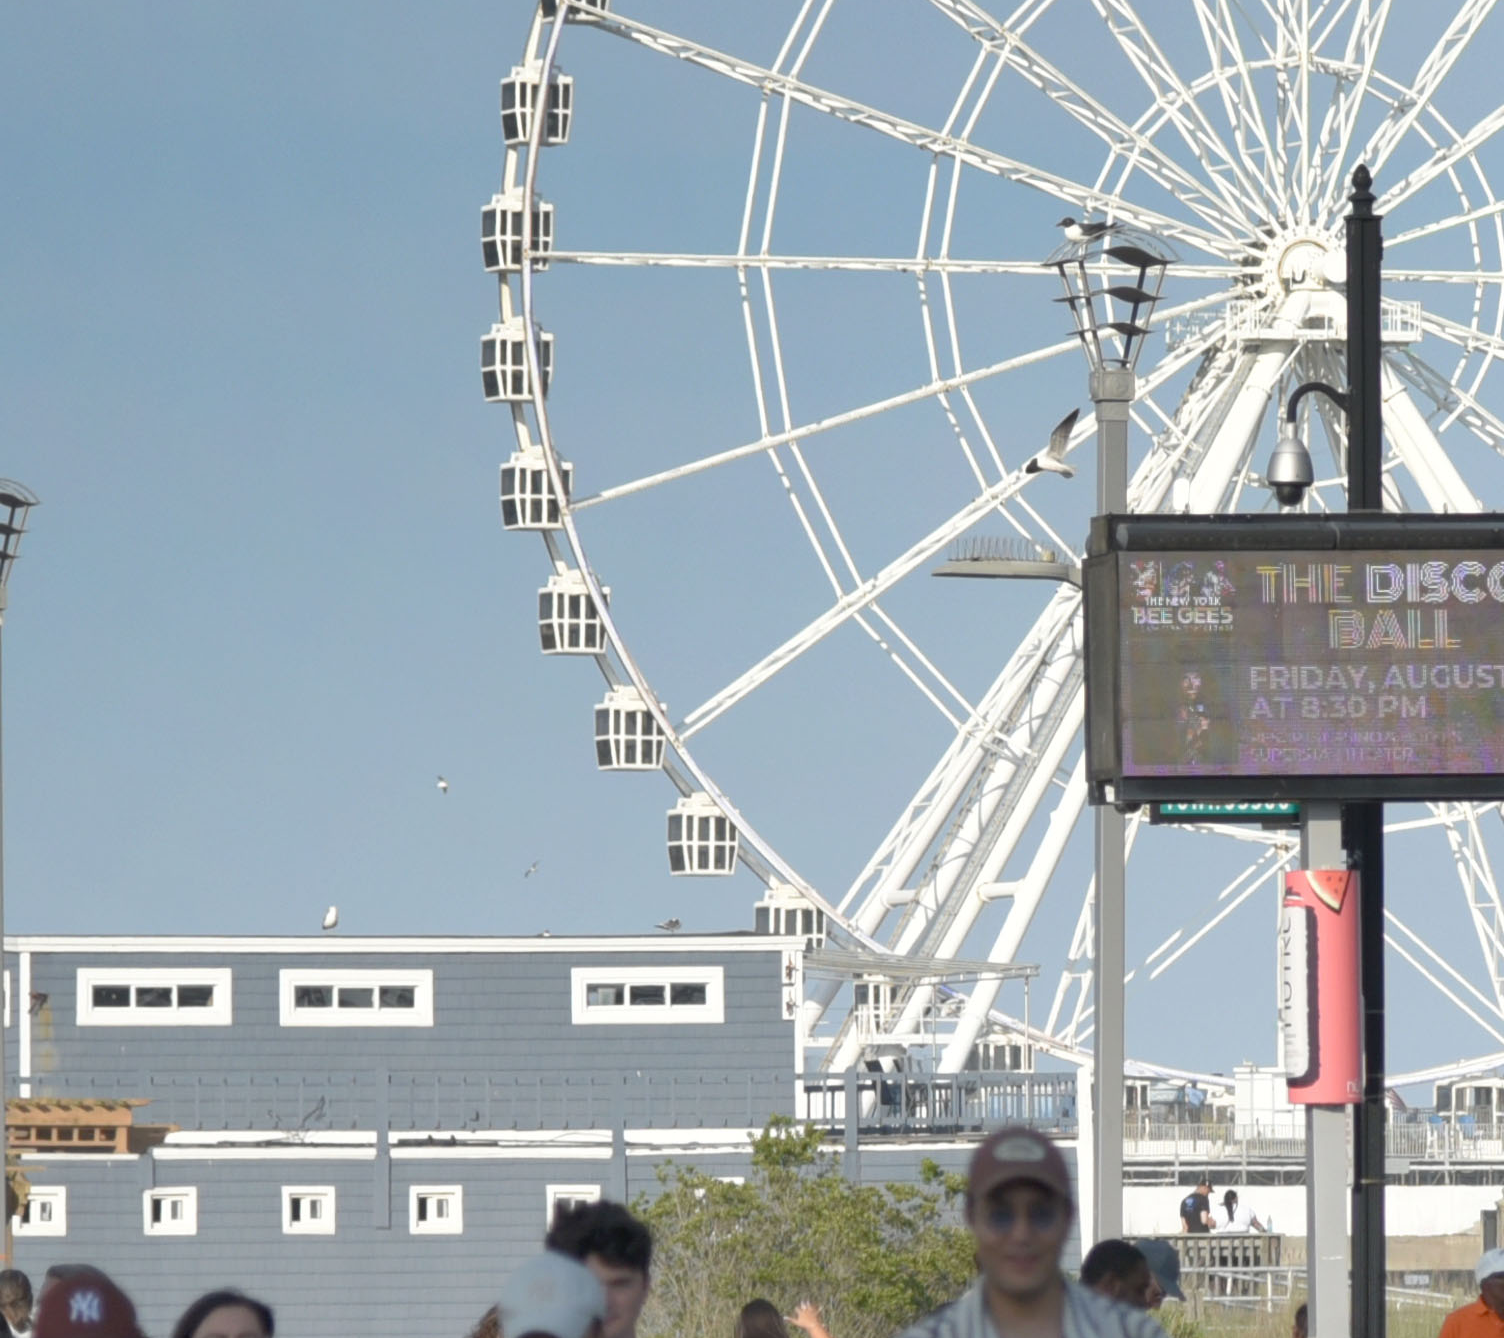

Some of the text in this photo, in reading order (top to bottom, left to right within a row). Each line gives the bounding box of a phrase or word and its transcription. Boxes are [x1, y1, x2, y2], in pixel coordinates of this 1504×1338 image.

[1255, 563, 1353, 604] THE
[1131, 606, 1234, 624] BEE GEES
[1327, 609, 1462, 649] BALL
[1249, 665, 1376, 694] FRIDAY,
[1250, 694, 1428, 719] AT 8:30 PM
